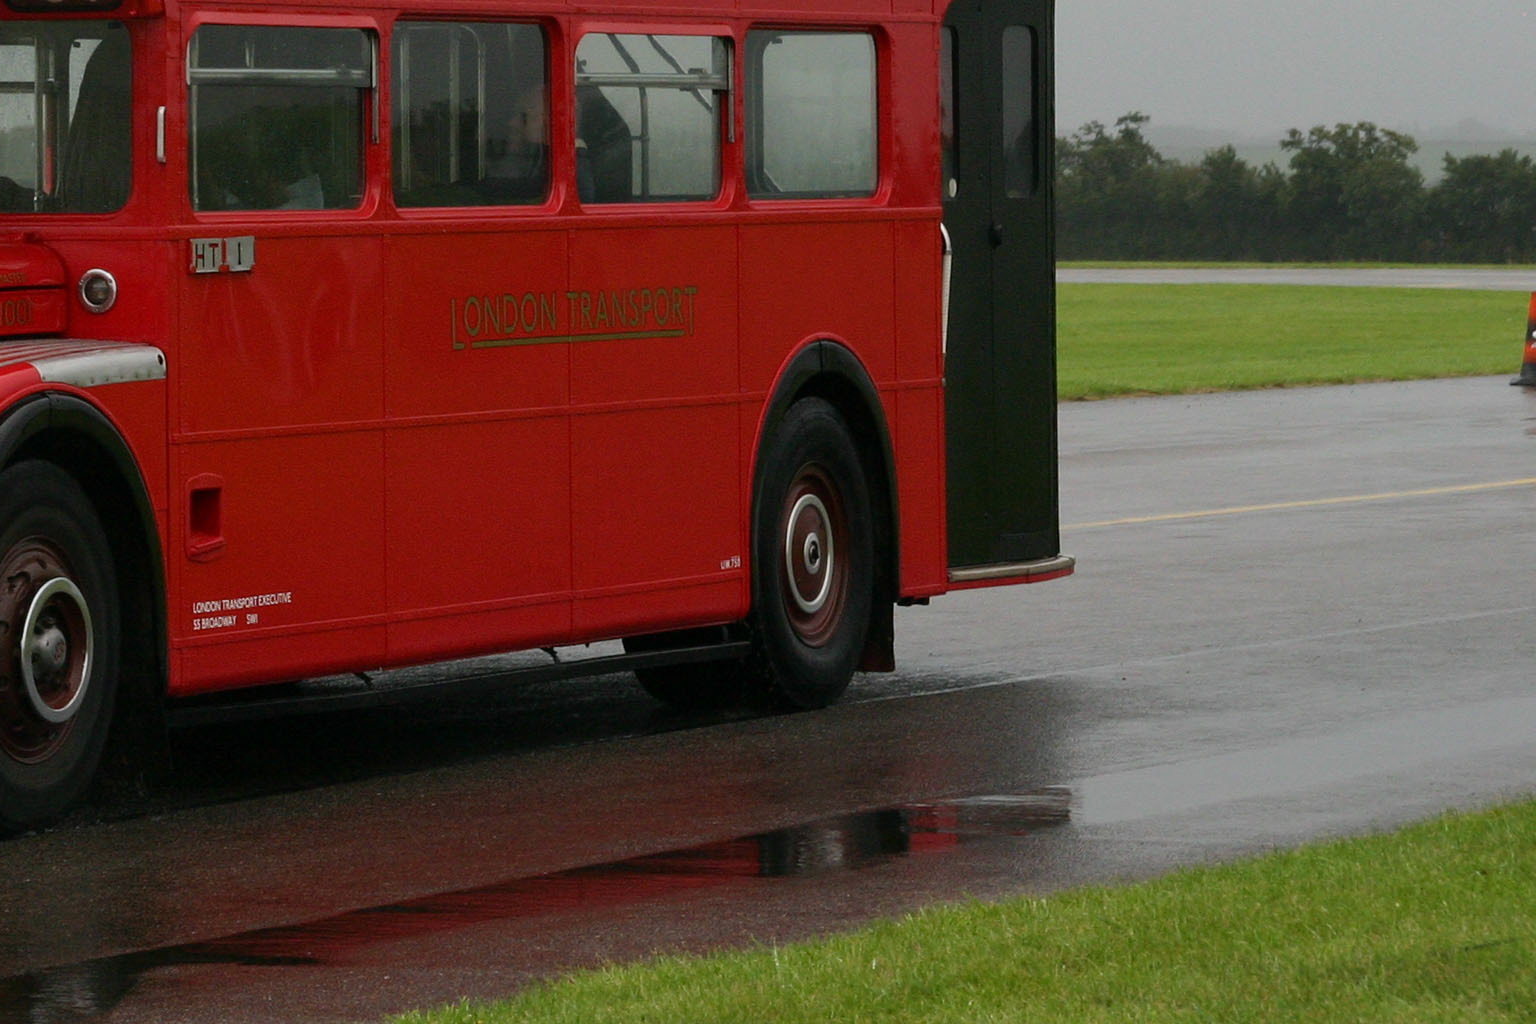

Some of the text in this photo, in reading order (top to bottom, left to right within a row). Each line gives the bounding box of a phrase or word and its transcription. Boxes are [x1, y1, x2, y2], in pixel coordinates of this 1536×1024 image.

[195, 243, 219, 268] HT
[451, 286, 698, 350] LONDON TRANSPORT
[192, 591, 292, 614] LONDON TRANSPORT EXECUTIVE
[201, 615, 237, 629] BROADWAY
